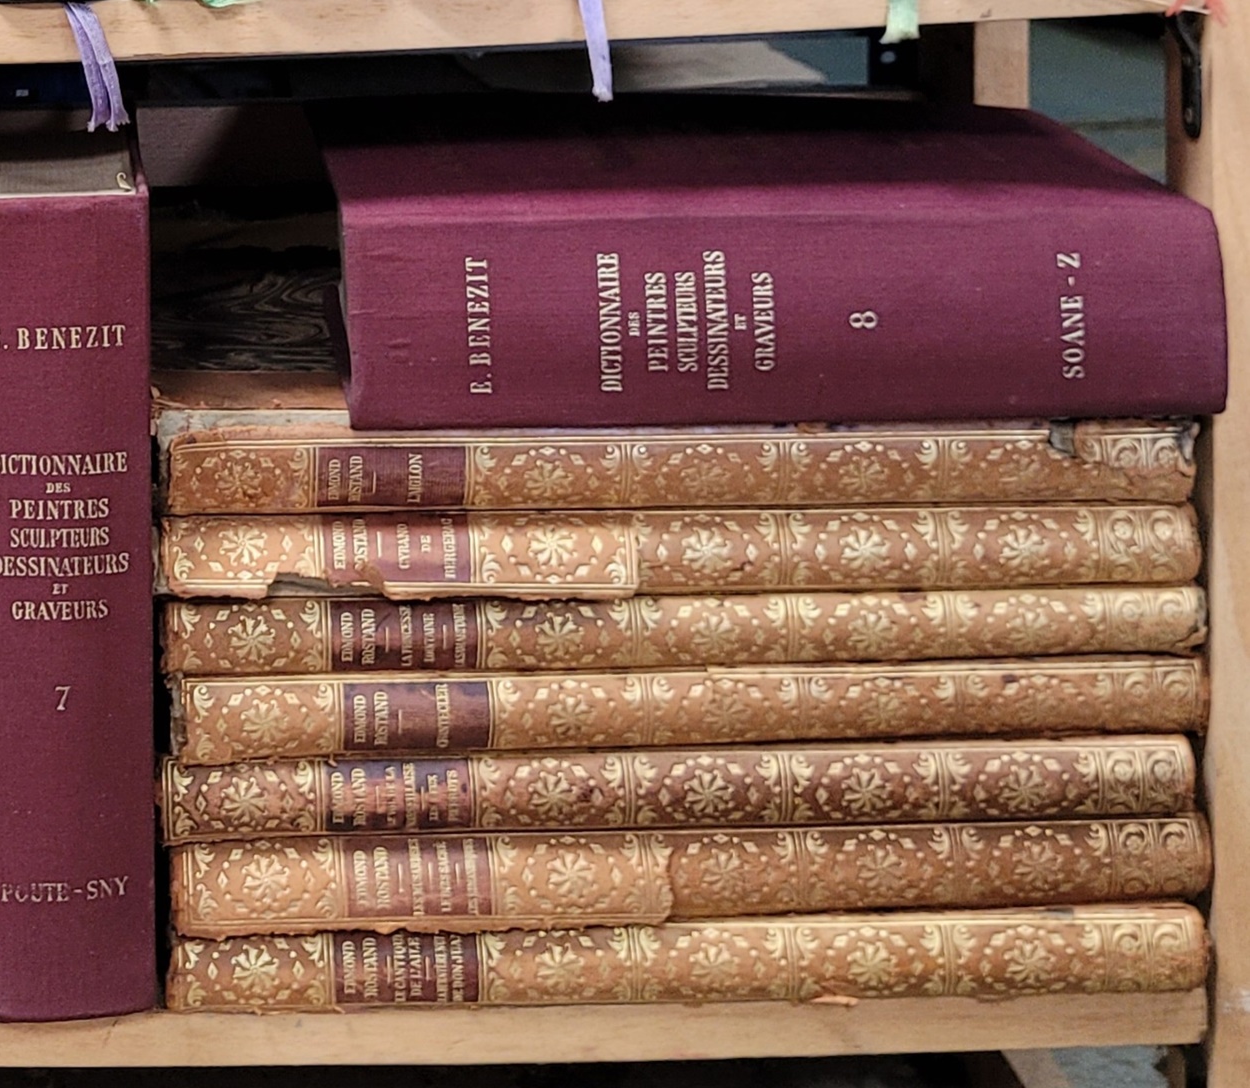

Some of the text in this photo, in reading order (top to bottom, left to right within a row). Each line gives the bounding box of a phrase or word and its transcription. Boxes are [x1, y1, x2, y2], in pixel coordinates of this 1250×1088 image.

[465, 256, 492, 367] BENEZIT
[596, 252, 623, 393] DICTIONNAIRE
[628, 311, 641, 337] DES
[644, 271, 669, 373] PEINTRES
[674, 271, 699, 373] SCULPTEURS
[702, 250, 730, 390] DESSINATEURS
[734, 313, 748, 331] ET
[751, 271, 776, 372] GRAVEURS
[848, 310, 879, 330] 8
[16, 324, 127, 350] BENEZIT
[45, 482, 72, 494] DES
[8, 498, 110, 521] PEINTRES
[10, 526, 110, 549] SCULPTEURS
[420, 535, 431, 553] DE
[52, 582, 70, 595] ET
[11, 599, 109, 621] GRAVEURS
[54, 685, 72, 711] 7
